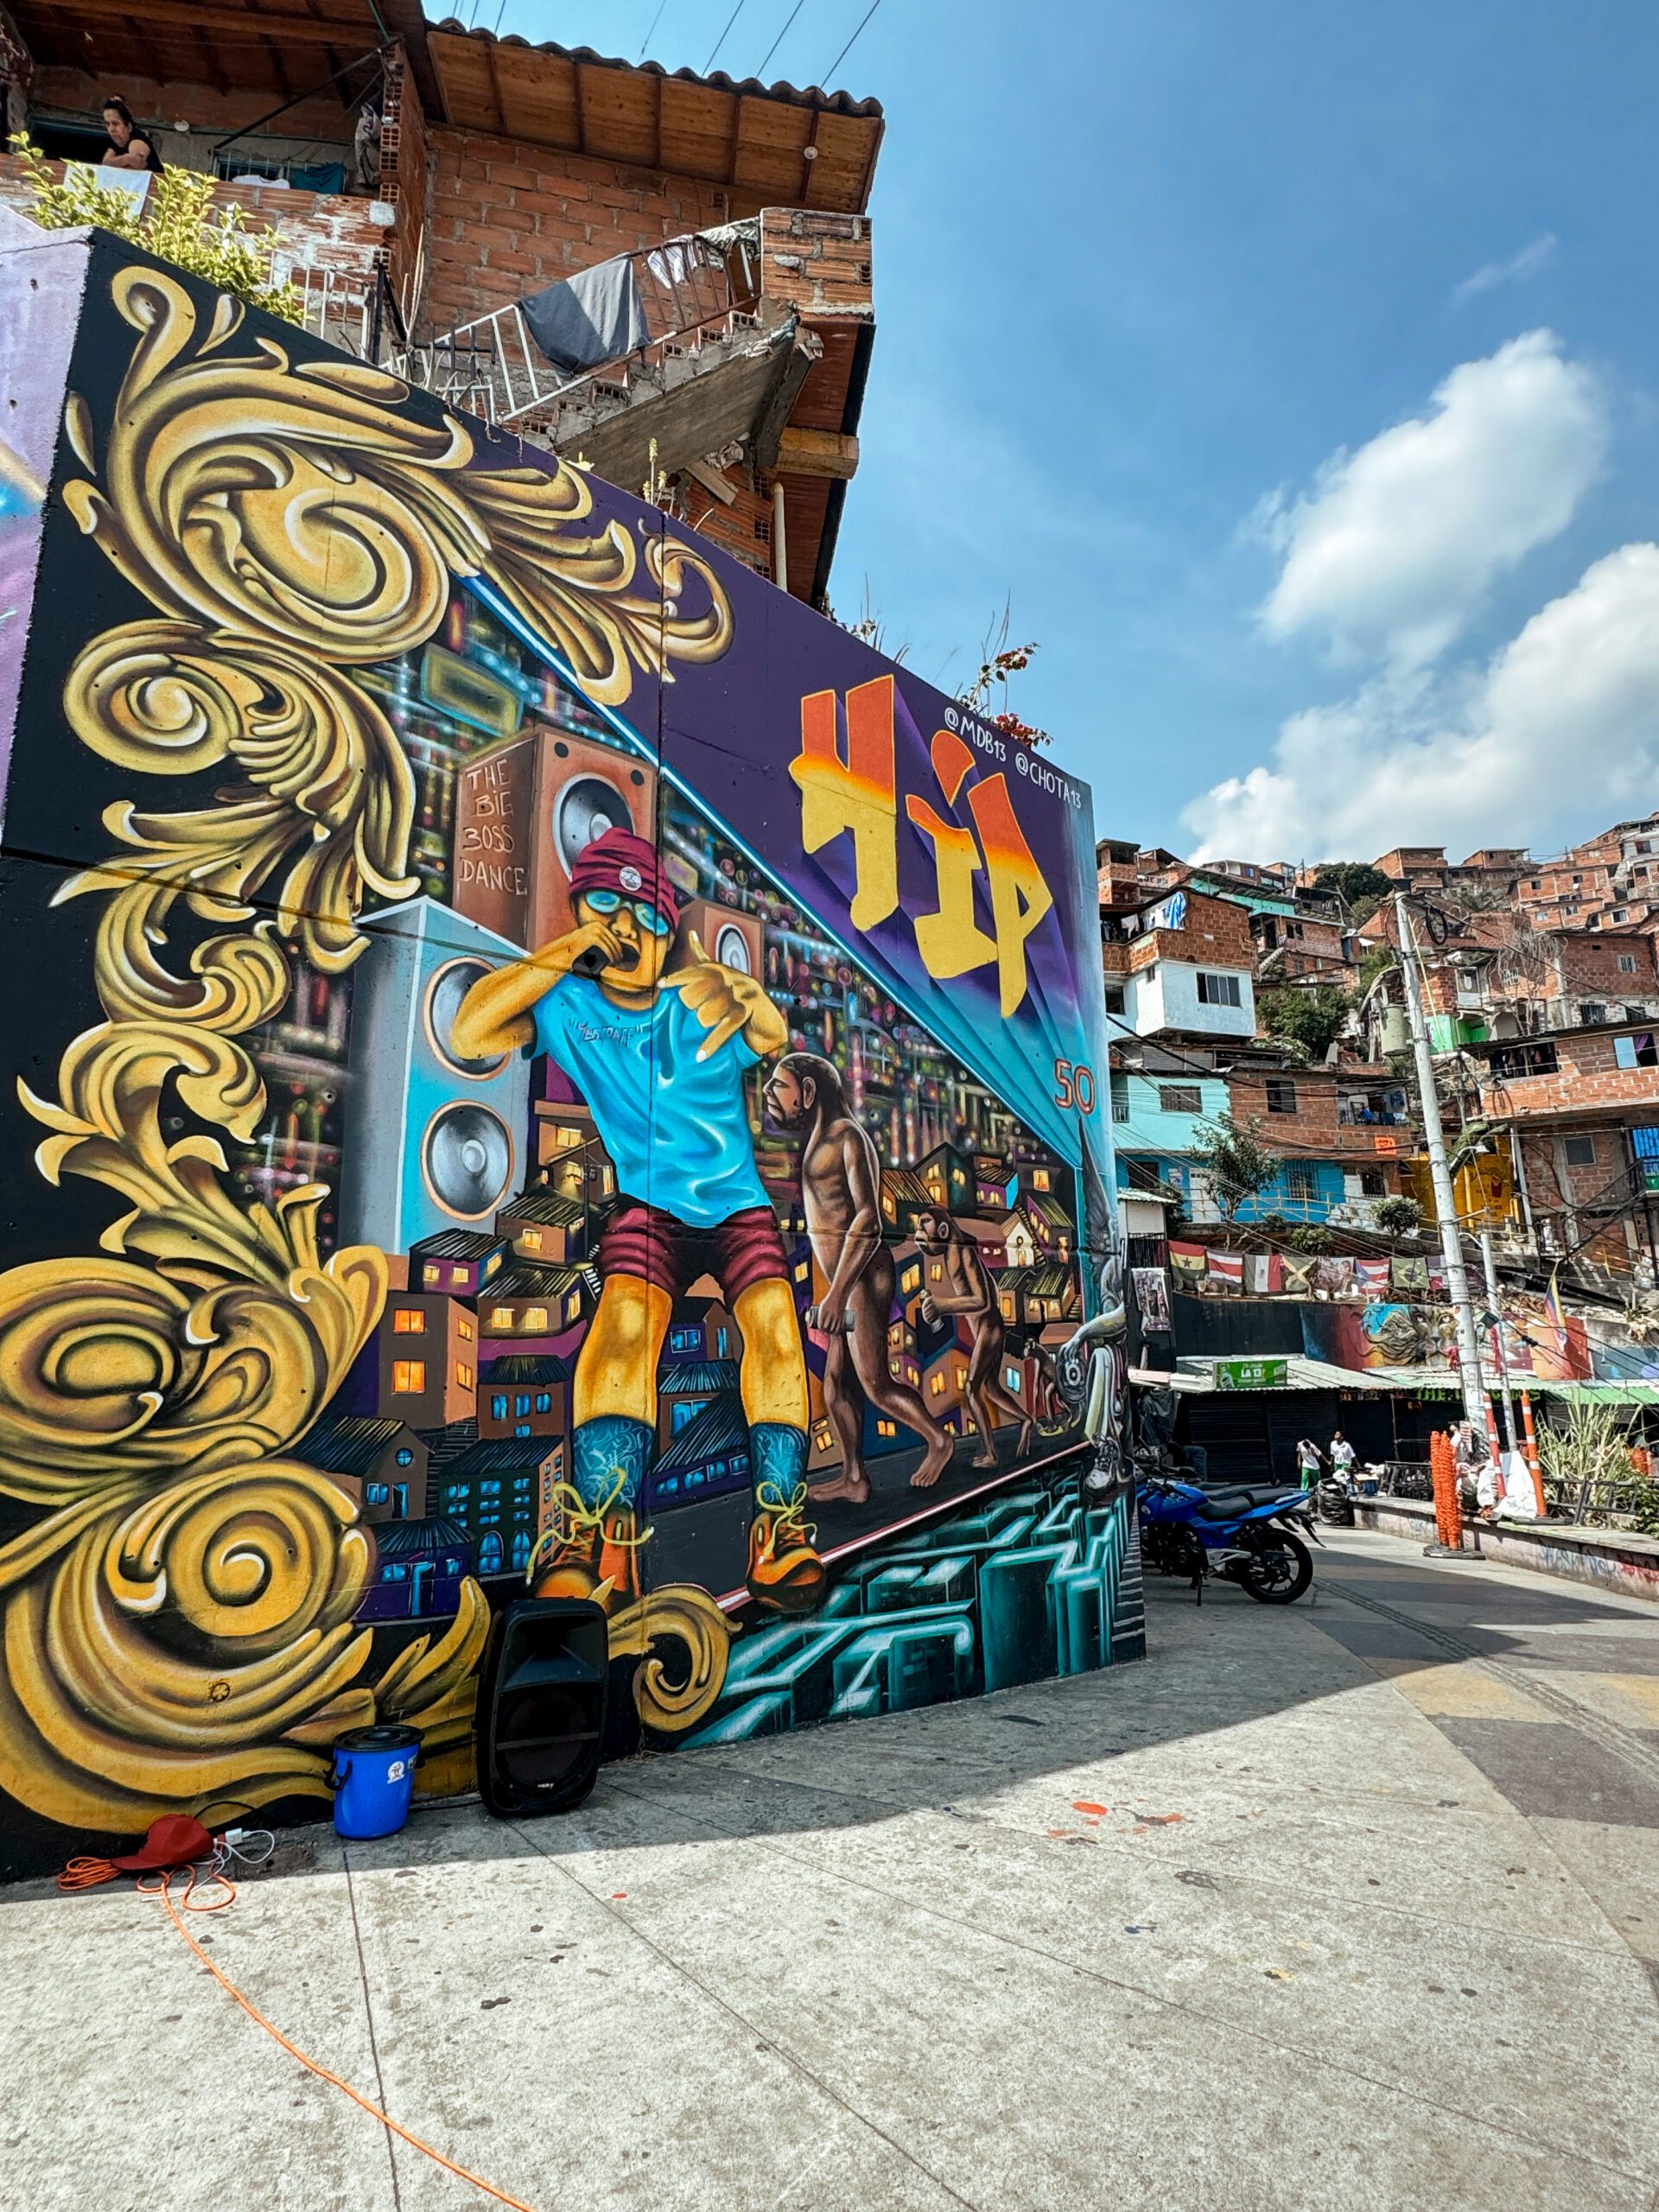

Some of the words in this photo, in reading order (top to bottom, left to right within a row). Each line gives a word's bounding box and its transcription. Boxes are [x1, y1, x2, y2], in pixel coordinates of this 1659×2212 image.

[467, 759, 512, 790] THE
[944, 707, 1007, 762] @MDB13
[1014, 752, 1082, 809] @CHOTA13
[458, 856, 528, 896] DANCE
[1055, 1058, 1095, 1115] 50
